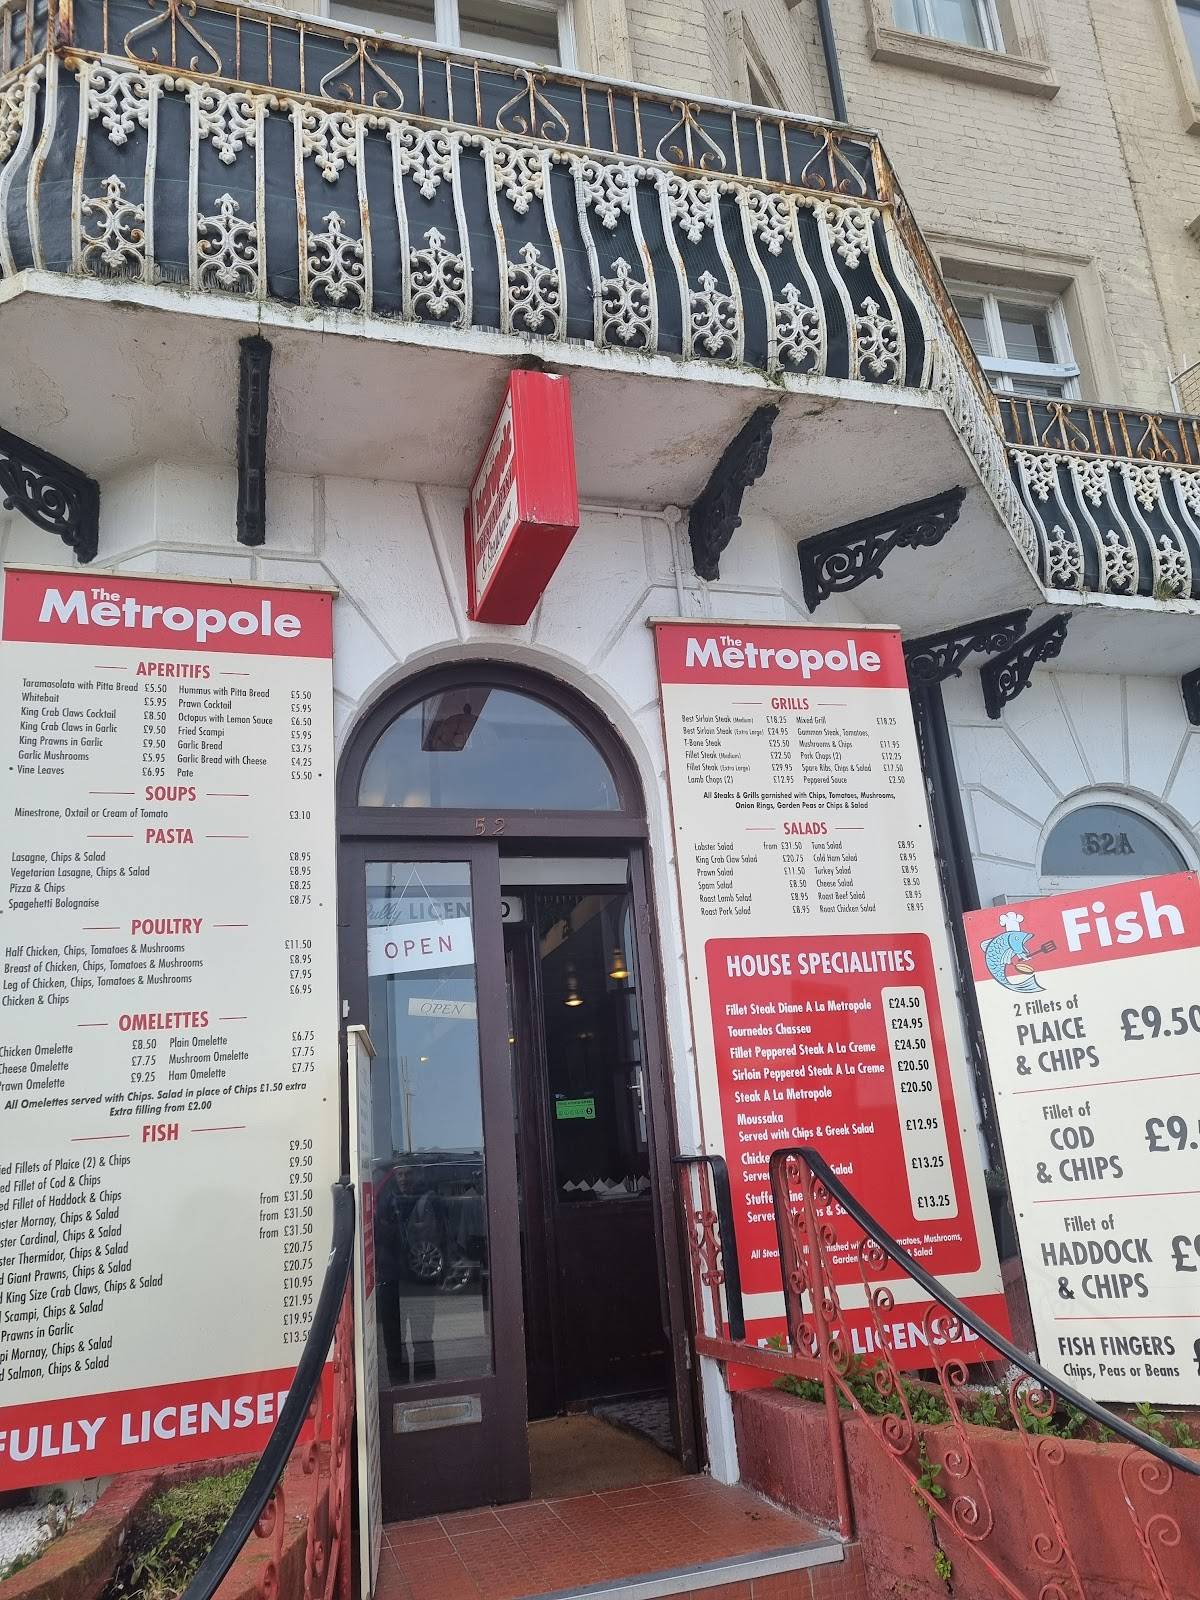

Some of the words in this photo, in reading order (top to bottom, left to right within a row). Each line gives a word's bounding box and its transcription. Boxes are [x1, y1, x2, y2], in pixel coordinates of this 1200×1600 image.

[91, 588, 121, 602] The
[38, 589, 302, 643] Metropole
[720, 636, 742, 646] The
[686, 637, 881, 679] Metropole
[136, 662, 211, 679] APERITIFS
[23, 678, 75, 690] Taramasolata
[77, 680, 94, 690] with
[96, 681, 114, 692] Pitta
[116, 683, 139, 692] Bread
[144, 683, 167, 694] £5.50
[178, 686, 209, 695] Hummus
[210, 687, 227, 696] with
[230, 687, 247, 697] Pitta
[249, 688, 270, 698] Bread
[290, 691, 312, 700] £5.50
[771, 697, 809, 710] GRILLS
[145, 786, 197, 802] SOUPS
[14, 807, 62, 818] Minestrone,
[65, 808, 89, 818] Oxtail
[91, 810, 100, 818] or
[102, 808, 128, 819] Cream
[130, 808, 139, 818] of
[140, 809, 168, 819] Tomato
[289, 810, 311, 820] £3.10
[756, 802, 775, 810] Rings,
[826, 802, 843, 810] Chips
[851, 801, 868, 809] Salad
[146, 828, 194, 844] PASTA
[475, 818, 505, 836] 52
[783, 822, 827, 835] SALADS
[1081, 831, 1135, 856] 52A
[131, 918, 203, 935] POULTRY
[1062, 891, 1185, 953] Fish
[6, 946, 23, 958] Half
[26, 946, 61, 958] Chicken,
[64, 945, 88, 957] Chips,
[90, 944, 129, 955] Tomatoes
[131, 944, 137, 954] &
[140, 943, 185, 954] Mushrooms
[285, 939, 312, 950] £11.50
[385, 936, 452, 959] OPEN
[726, 954, 792, 978] HOUSE
[798, 950, 915, 974] SPECIALITIES
[420, 1003, 467, 1015] OPEN
[726, 1004, 748, 1016] Fillet
[751, 1004, 776, 1015] Steak
[778, 1003, 803, 1014] Diane
[806, 1002, 813, 1012] A
[815, 1001, 826, 1012] La
[828, 999, 872, 1013] Metropole
[889, 997, 920, 1009] £24.50
[1013, 1004, 1022, 1016] 2
[1025, 999, 1062, 1016] Fillets
[1066, 994, 1079, 1009] of
[118, 1010, 209, 1031] OMELETTES
[728, 1025, 773, 1037] Tournedos
[775, 1024, 811, 1035] Chasseu
[892, 1018, 923, 1030] £24.95
[1017, 1017, 1086, 1046] PLAICE
[168, 1051, 211, 1065] Mushroom
[213, 1049, 249, 1063] Omelette
[292, 1046, 315, 1057] £7.75
[730, 1046, 753, 1059] Fillet
[755, 1044, 797, 1059] Peppered
[799, 1044, 824, 1055] Steak
[827, 1043, 834, 1054] A
[836, 1043, 847, 1054] La
[849, 1042, 876, 1053] Creme
[895, 1039, 926, 1051] £24.50
[1016, 1055, 1032, 1076] &
[1038, 1046, 1100, 1072] CHIPS
[732, 1068, 761, 1081] Sirloin
[763, 1066, 805, 1082] Peppered
[808, 1065, 833, 1078] Steak
[836, 1065, 842, 1075] A
[845, 1064, 855, 1075] La
[857, 1063, 885, 1074] Creme
[898, 1060, 929, 1072] £20.50
[735, 1091, 761, 1103] Steak
[763, 1090, 770, 1101] A
[773, 1089, 784, 1100] La
[786, 1087, 832, 1102] Metropole
[901, 1081, 932, 1093] £20.50
[109, 1106, 132, 1117] Extra
[135, 1103, 162, 1117] filling
[164, 1103, 185, 1113] from
[187, 1101, 212, 1111] £2.00
[1043, 1105, 1073, 1121] Fillet
[1078, 1101, 1091, 1117] of
[737, 1113, 784, 1125] Moussaka
[142, 1123, 179, 1143] FISH
[739, 1130, 768, 1142] Served
[770, 1129, 789, 1140] with
[792, 1128, 814, 1141] Chips
[816, 1126, 823, 1137] &
[825, 1124, 850, 1136] Greek
[852, 1123, 874, 1135] Salad
[906, 1118, 938, 1131] £12.95
[1050, 1126, 1095, 1150] COD
[1145, 1115, 1200, 1152] £9.
[15, 1158, 40, 1175] Fillets
[42, 1156, 52, 1172] of
[55, 1154, 80, 1170] Plaice
[83, 1153, 96, 1169] (2)
[99, 1155, 106, 1166] &
[109, 1150, 131, 1166] Chips
[289, 1139, 312, 1150] £9.50
[741, 1152, 770, 1165] Chicke
[912, 1156, 944, 1169] £13.25
[1036, 1162, 1052, 1184] &
[1059, 1155, 1124, 1182] CHIPS
[745, 1192, 773, 1206] Stuffe
[918, 1195, 950, 1208] £13.25
[1064, 1216, 1096, 1232] Fillet
[1101, 1213, 1115, 1231] of
[924, 1233, 962, 1244] Mushrooms,
[751, 1249, 762, 1259] All
[832, 1254, 858, 1264] Garden
[914, 1248, 933, 1257] Salad
[1040, 1238, 1153, 1267] HADDOCK
[1058, 1277, 1075, 1300] &
[1082, 1273, 1149, 1298] CHIPS
[1058, 1336, 1094, 1356] FISH
[1102, 1336, 1176, 1356] FINGERS
[1063, 1364, 1096, 1379] Chips,
[1100, 1365, 1126, 1378] Peas
[1130, 1366, 1141, 1377] or
[1145, 1363, 1179, 1377] Beans
